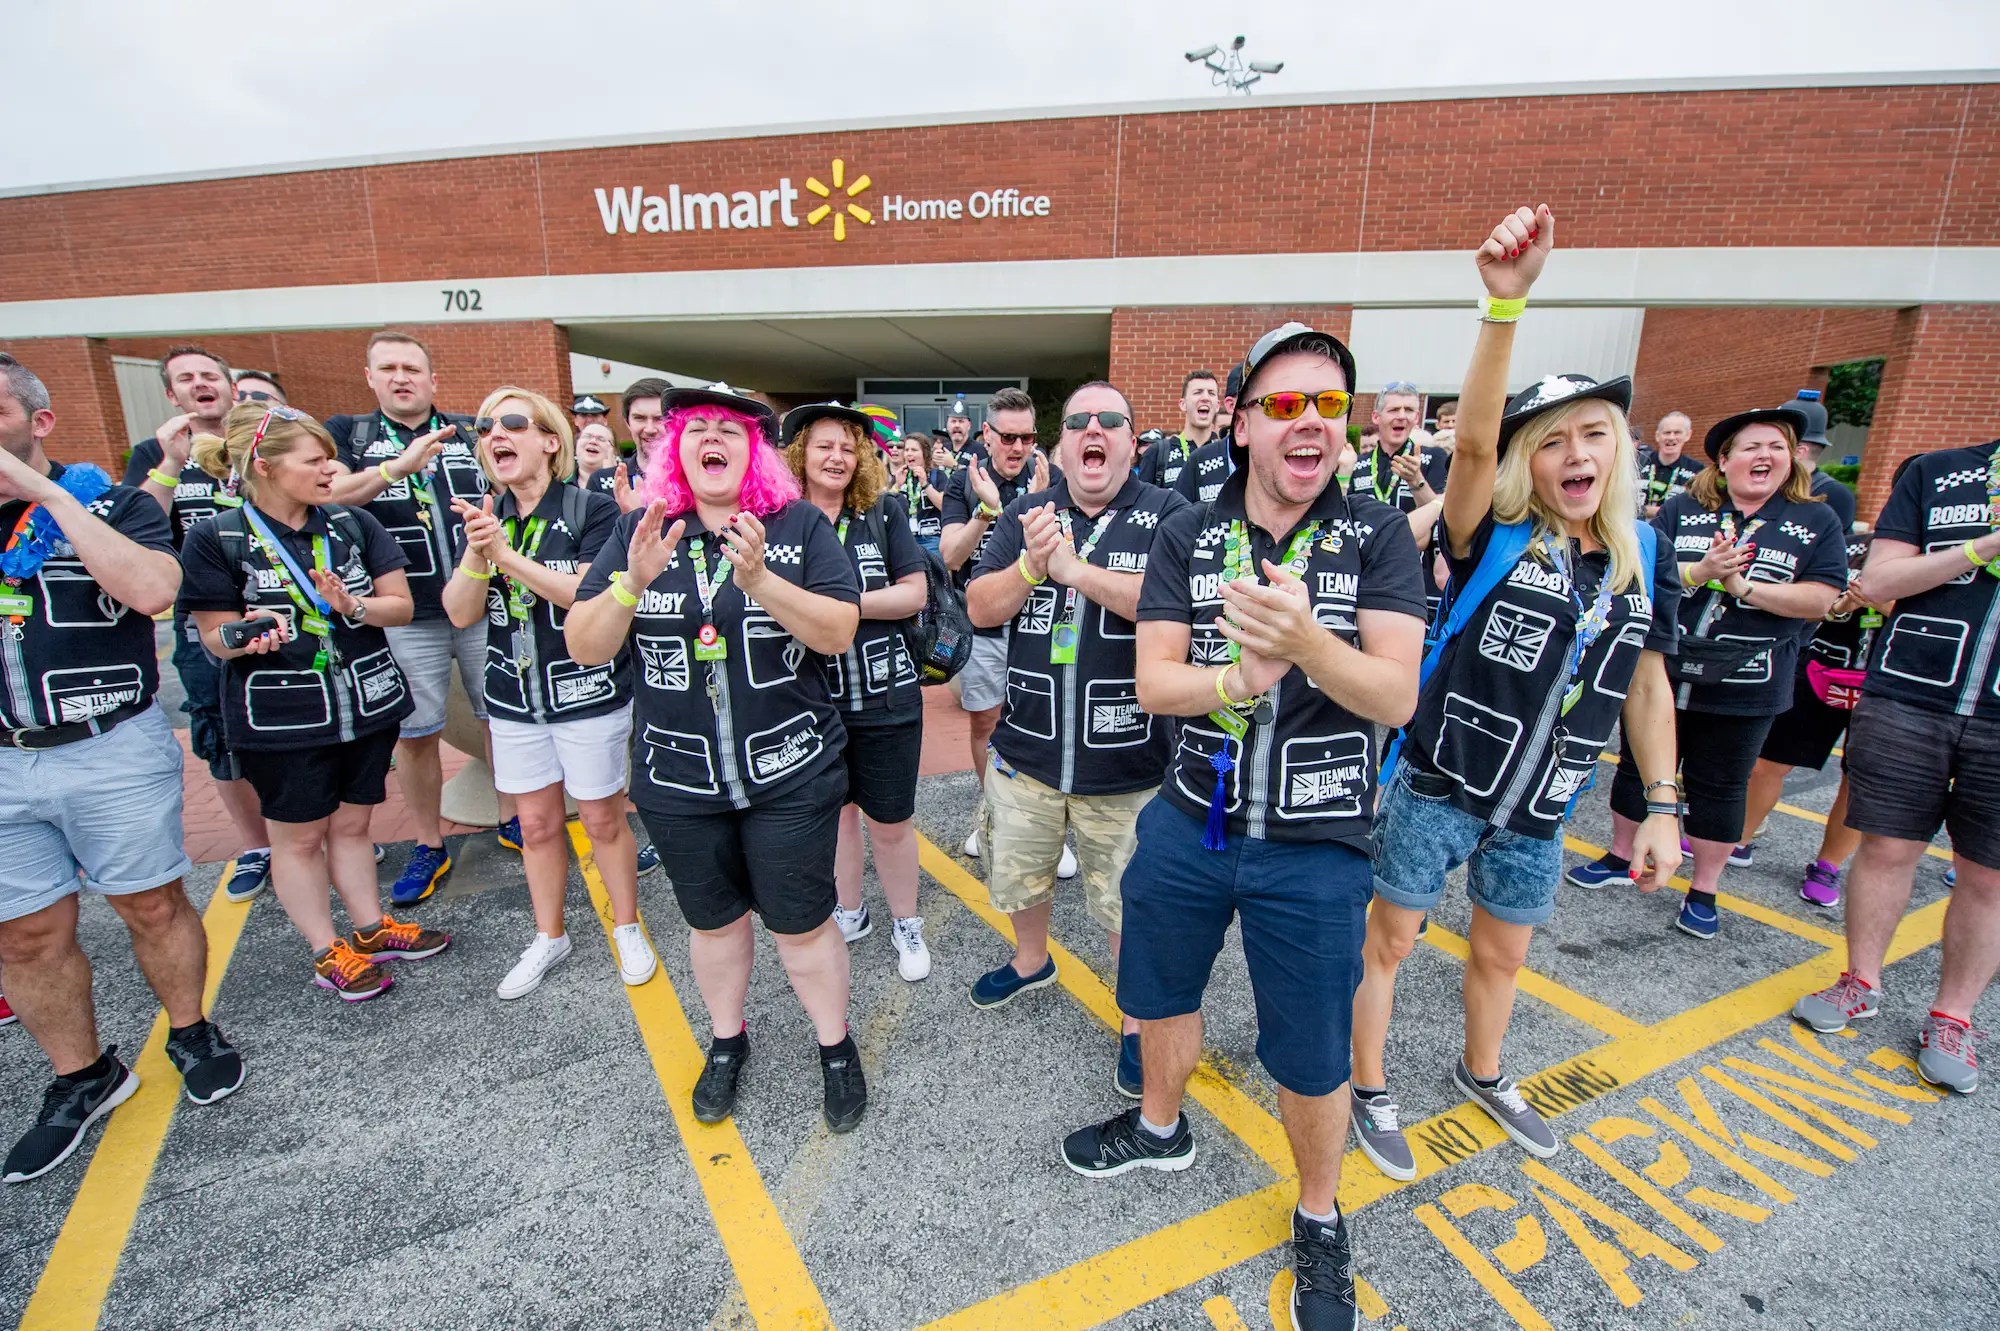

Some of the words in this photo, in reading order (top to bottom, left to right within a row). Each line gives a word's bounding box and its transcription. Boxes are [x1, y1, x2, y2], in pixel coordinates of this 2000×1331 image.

[594, 177, 799, 235] Walmart
[883, 195, 964, 221] Home
[968, 188, 1051, 219] Office
[441, 289, 482, 311] 702
[1928, 504, 1990, 526] BOBBY
[1108, 552, 1137, 569] TEAM
[1758, 548, 1787, 564] TEAM
[1317, 572, 1358, 596] TEAM
[780, 747, 803, 767] 2016
[1319, 782, 1344, 799] 2016
[1416, 1117, 1483, 1165] NO
[1517, 1059, 1619, 1119] RKING
[1414, 1022, 1949, 1331] PARKING
